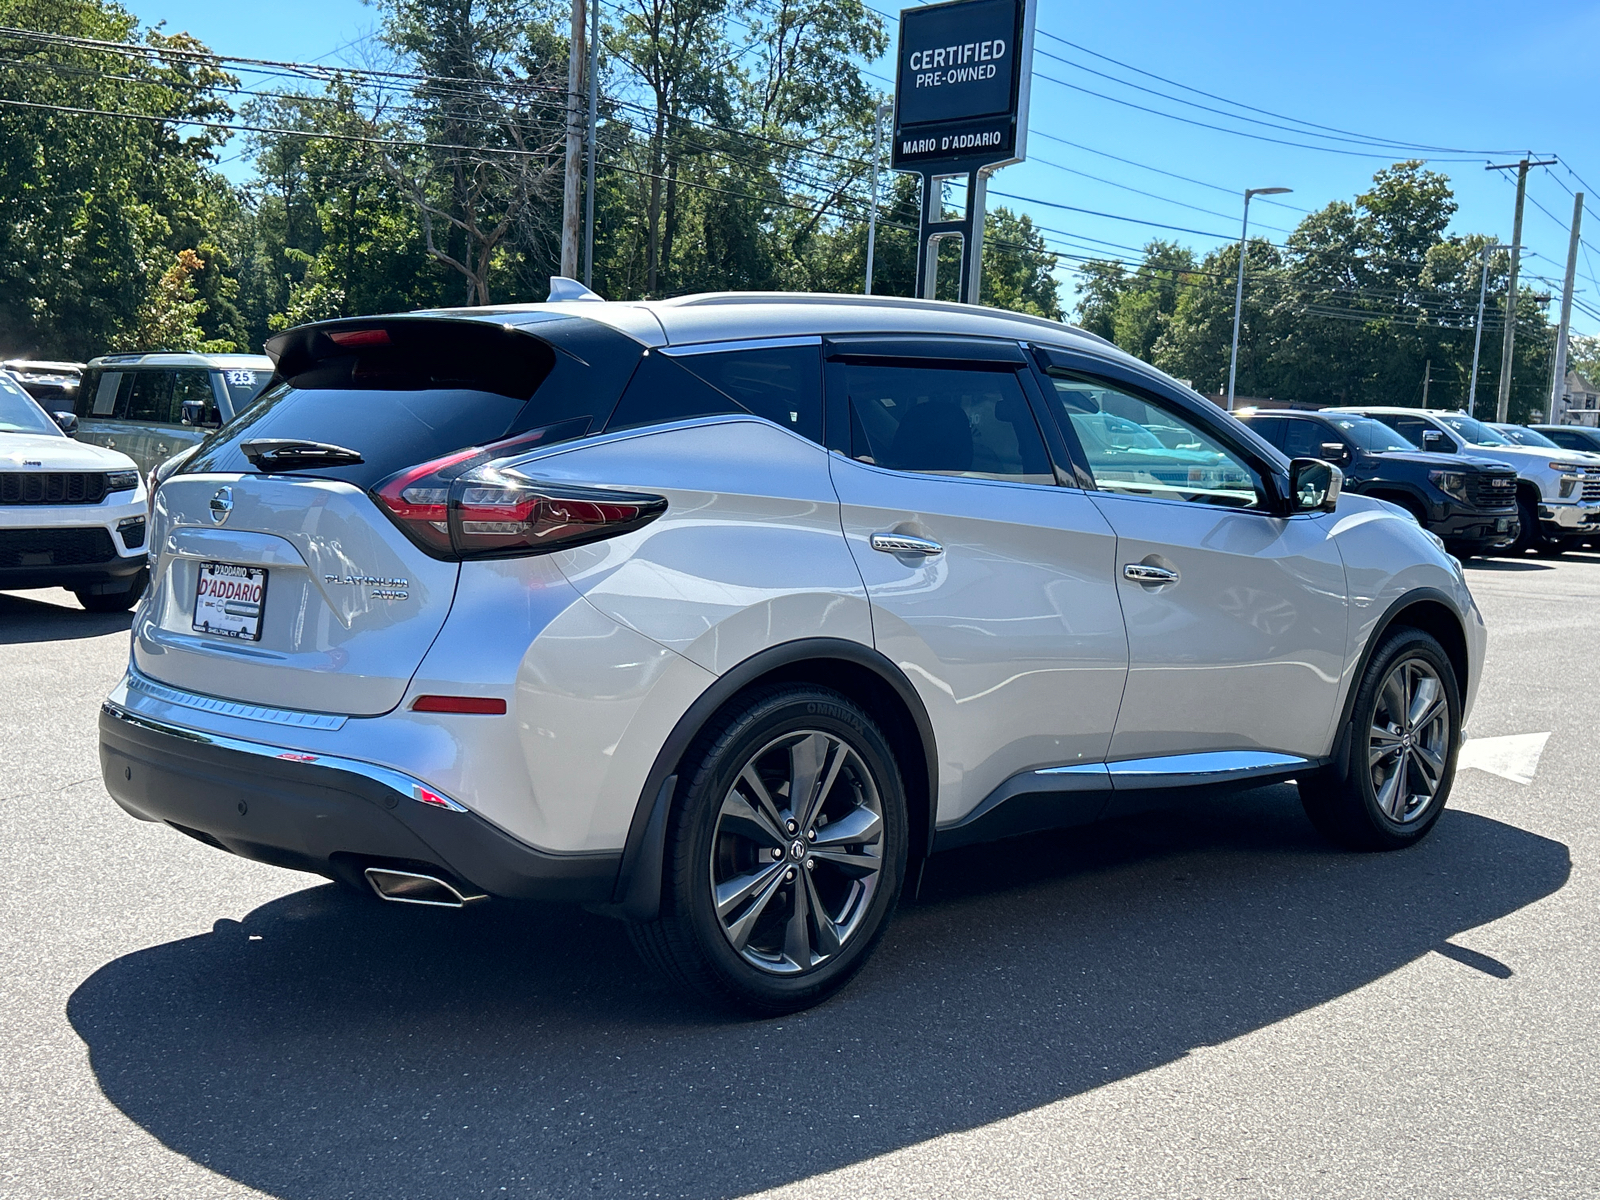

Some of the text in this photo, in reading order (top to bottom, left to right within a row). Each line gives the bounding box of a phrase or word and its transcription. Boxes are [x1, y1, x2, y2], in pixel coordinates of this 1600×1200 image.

[909, 39, 1006, 71] CERTIFIED
[915, 64, 996, 88] PRE-OWNED
[902, 131, 1001, 154] MARIO D'ADDARIO
[233, 372, 250, 382] 25
[215, 565, 247, 577] D'ADDARIO
[324, 574, 409, 588] PLATINUM
[199, 578, 262, 602] D'ADDARIO
[370, 589, 409, 601] AWD
[806, 702, 866, 735] OMNIMAX
